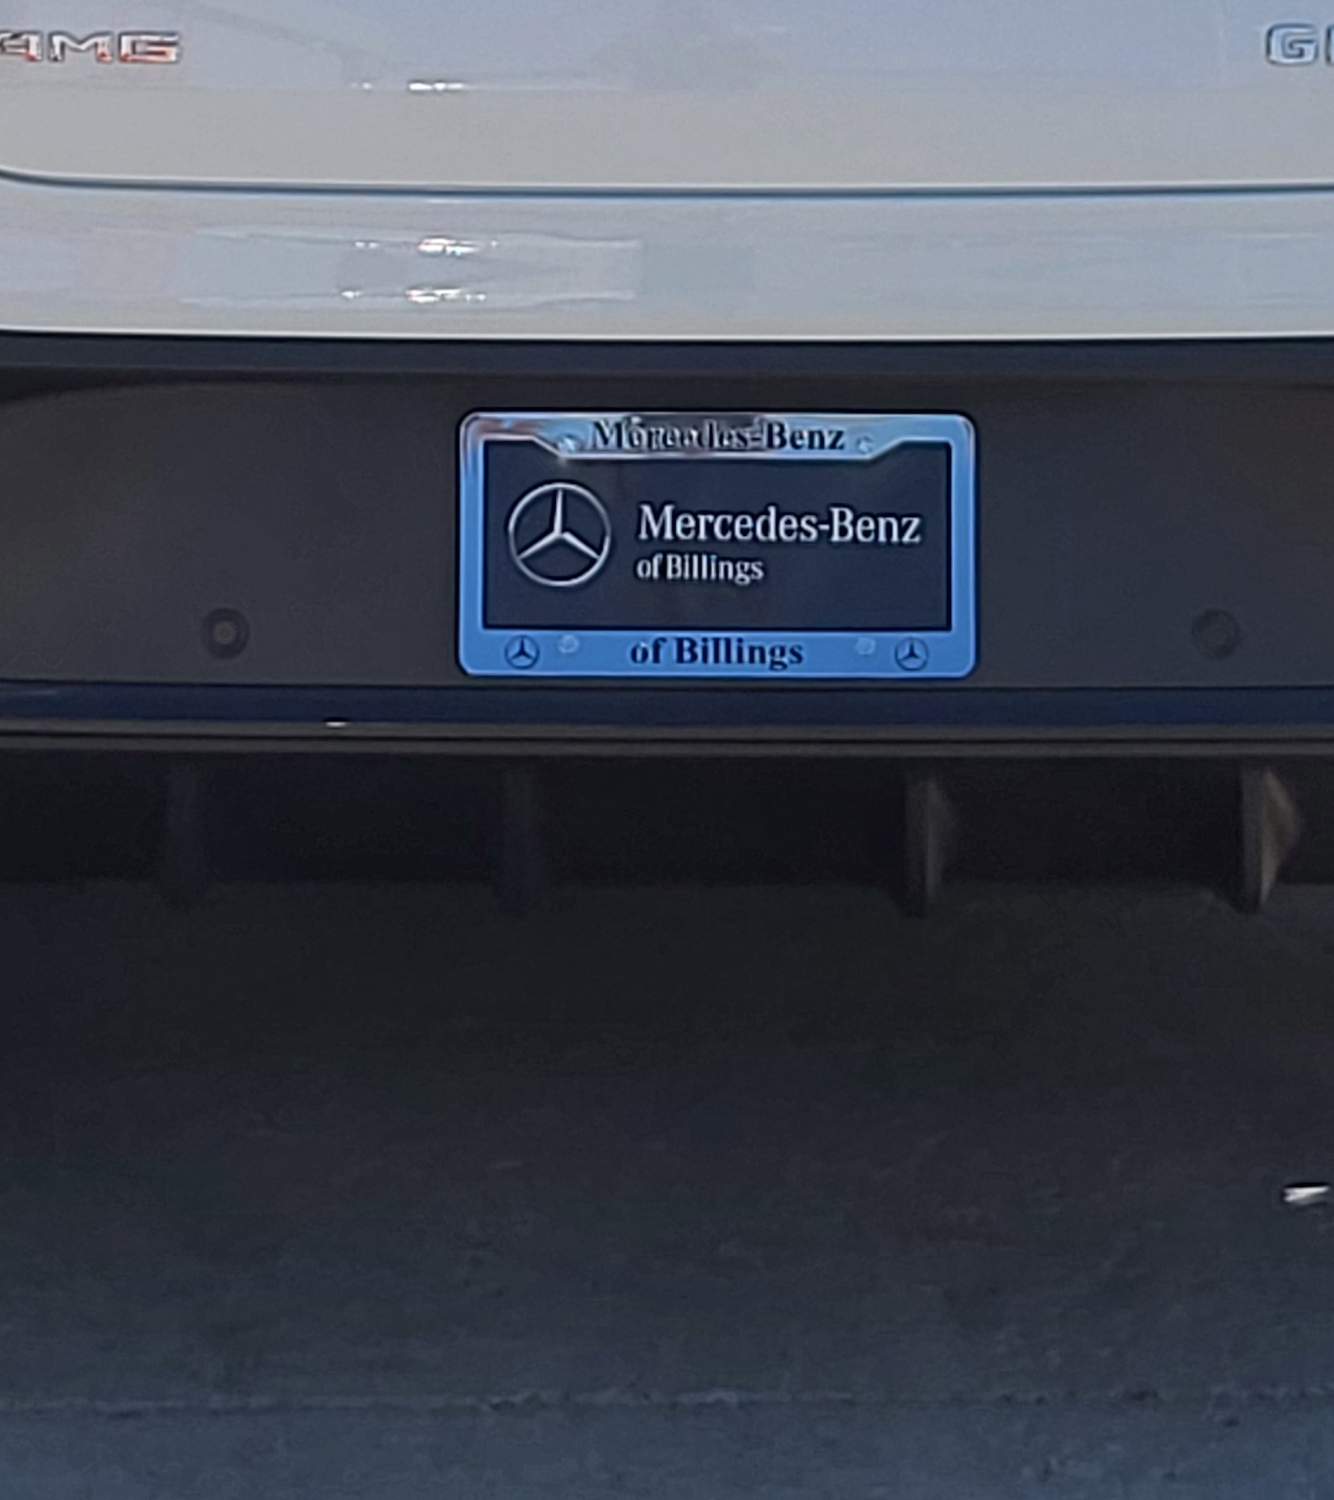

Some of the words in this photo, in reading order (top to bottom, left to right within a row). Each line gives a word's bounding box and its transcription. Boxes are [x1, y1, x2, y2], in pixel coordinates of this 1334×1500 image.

[638, 503, 922, 543] Mercedes-Benz
[636, 552, 663, 580] of
[666, 552, 765, 586] Billings
[630, 636, 668, 665] of
[673, 636, 804, 672] Billings
